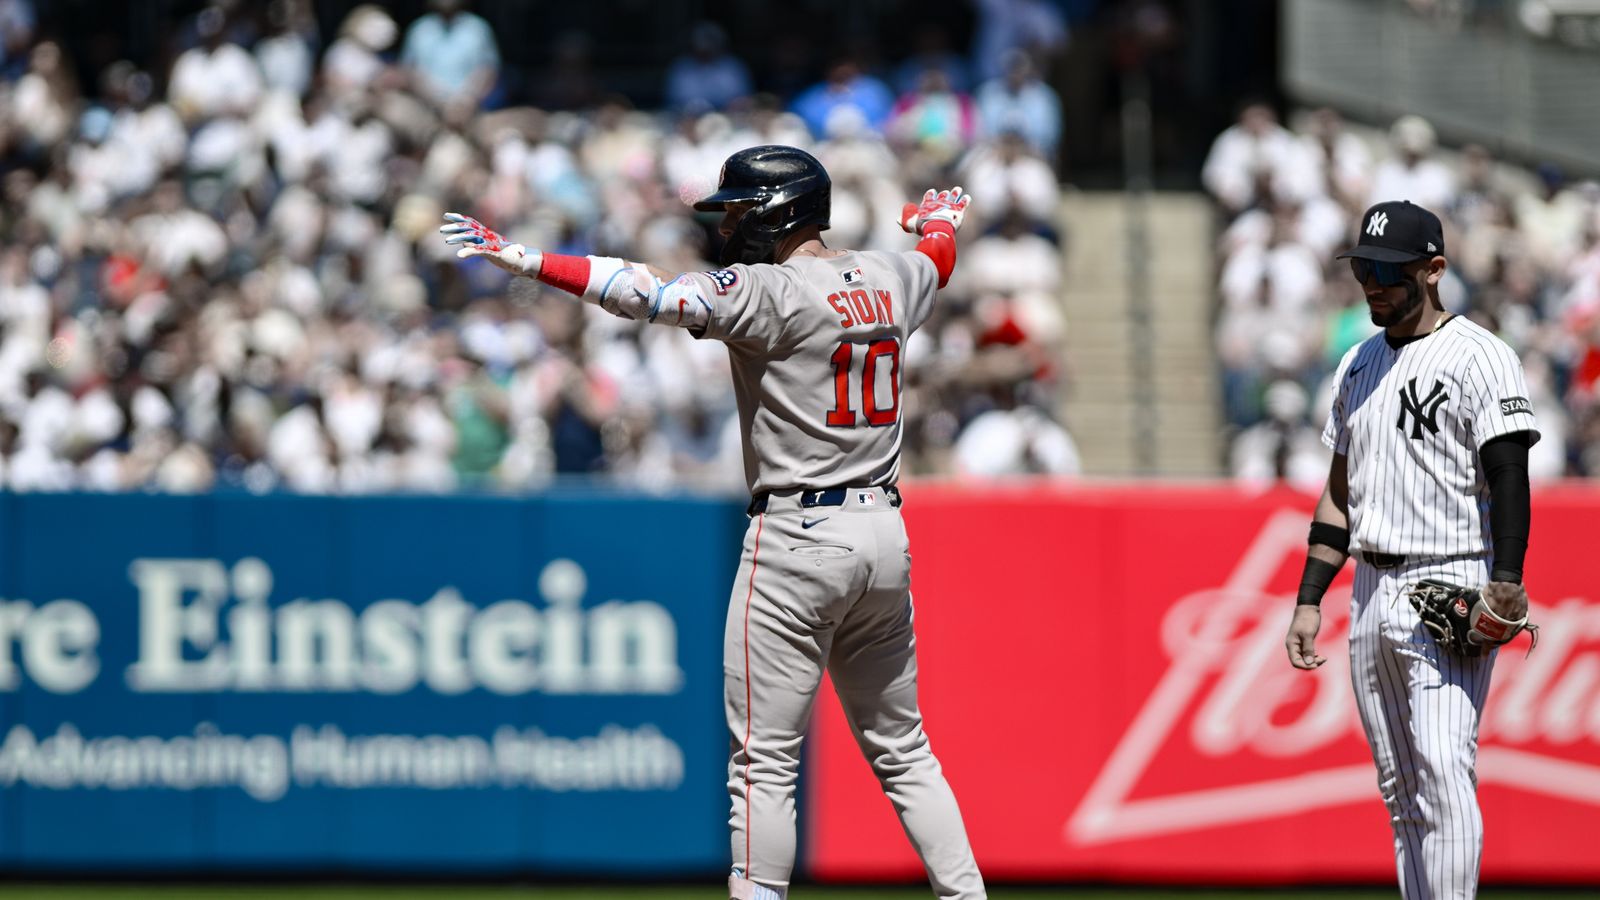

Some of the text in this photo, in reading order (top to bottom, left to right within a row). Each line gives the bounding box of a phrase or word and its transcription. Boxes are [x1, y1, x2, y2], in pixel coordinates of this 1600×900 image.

[826, 337, 900, 428] 10
[127, 557, 684, 694] Einstein
[2, 723, 684, 800] Advancing Human Health
